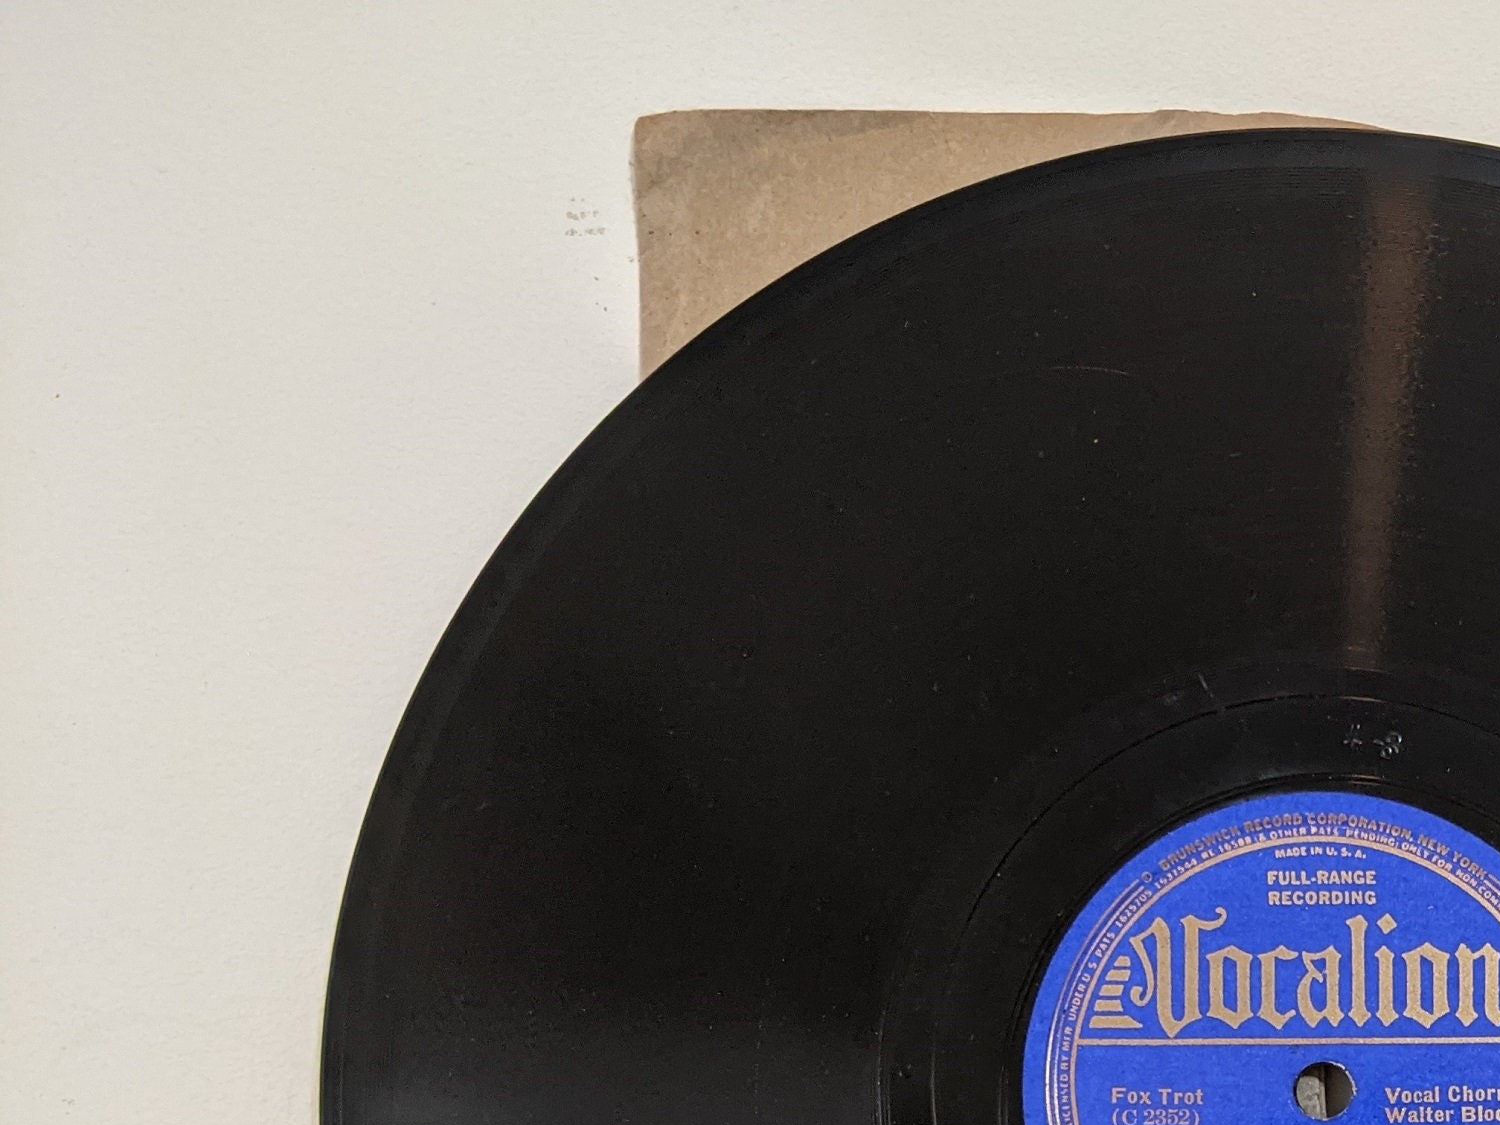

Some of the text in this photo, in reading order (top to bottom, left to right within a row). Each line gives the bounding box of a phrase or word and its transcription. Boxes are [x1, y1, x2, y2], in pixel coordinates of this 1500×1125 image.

[1159, 813, 1488, 880] BRUNSWICK RECORD CORPORATION, NEW YORK
[1275, 847, 1307, 859] MADE
[1310, 846, 1323, 856] IN
[1267, 870, 1377, 886] FULL-RANGE
[1268, 891, 1377, 906] RECORDING
[1068, 984, 1087, 1021] UNDER
[1115, 889, 1153, 929] 1625705
[1269, 826, 1307, 840] OTHER
[1401, 842, 1431, 859] ONLY
[1431, 855, 1453, 871] FOR
[1111, 1087, 1204, 1105] Fox Trot
[1385, 1086, 1440, 1104] Vocal
[1385, 1106, 1454, 1124] Walter
